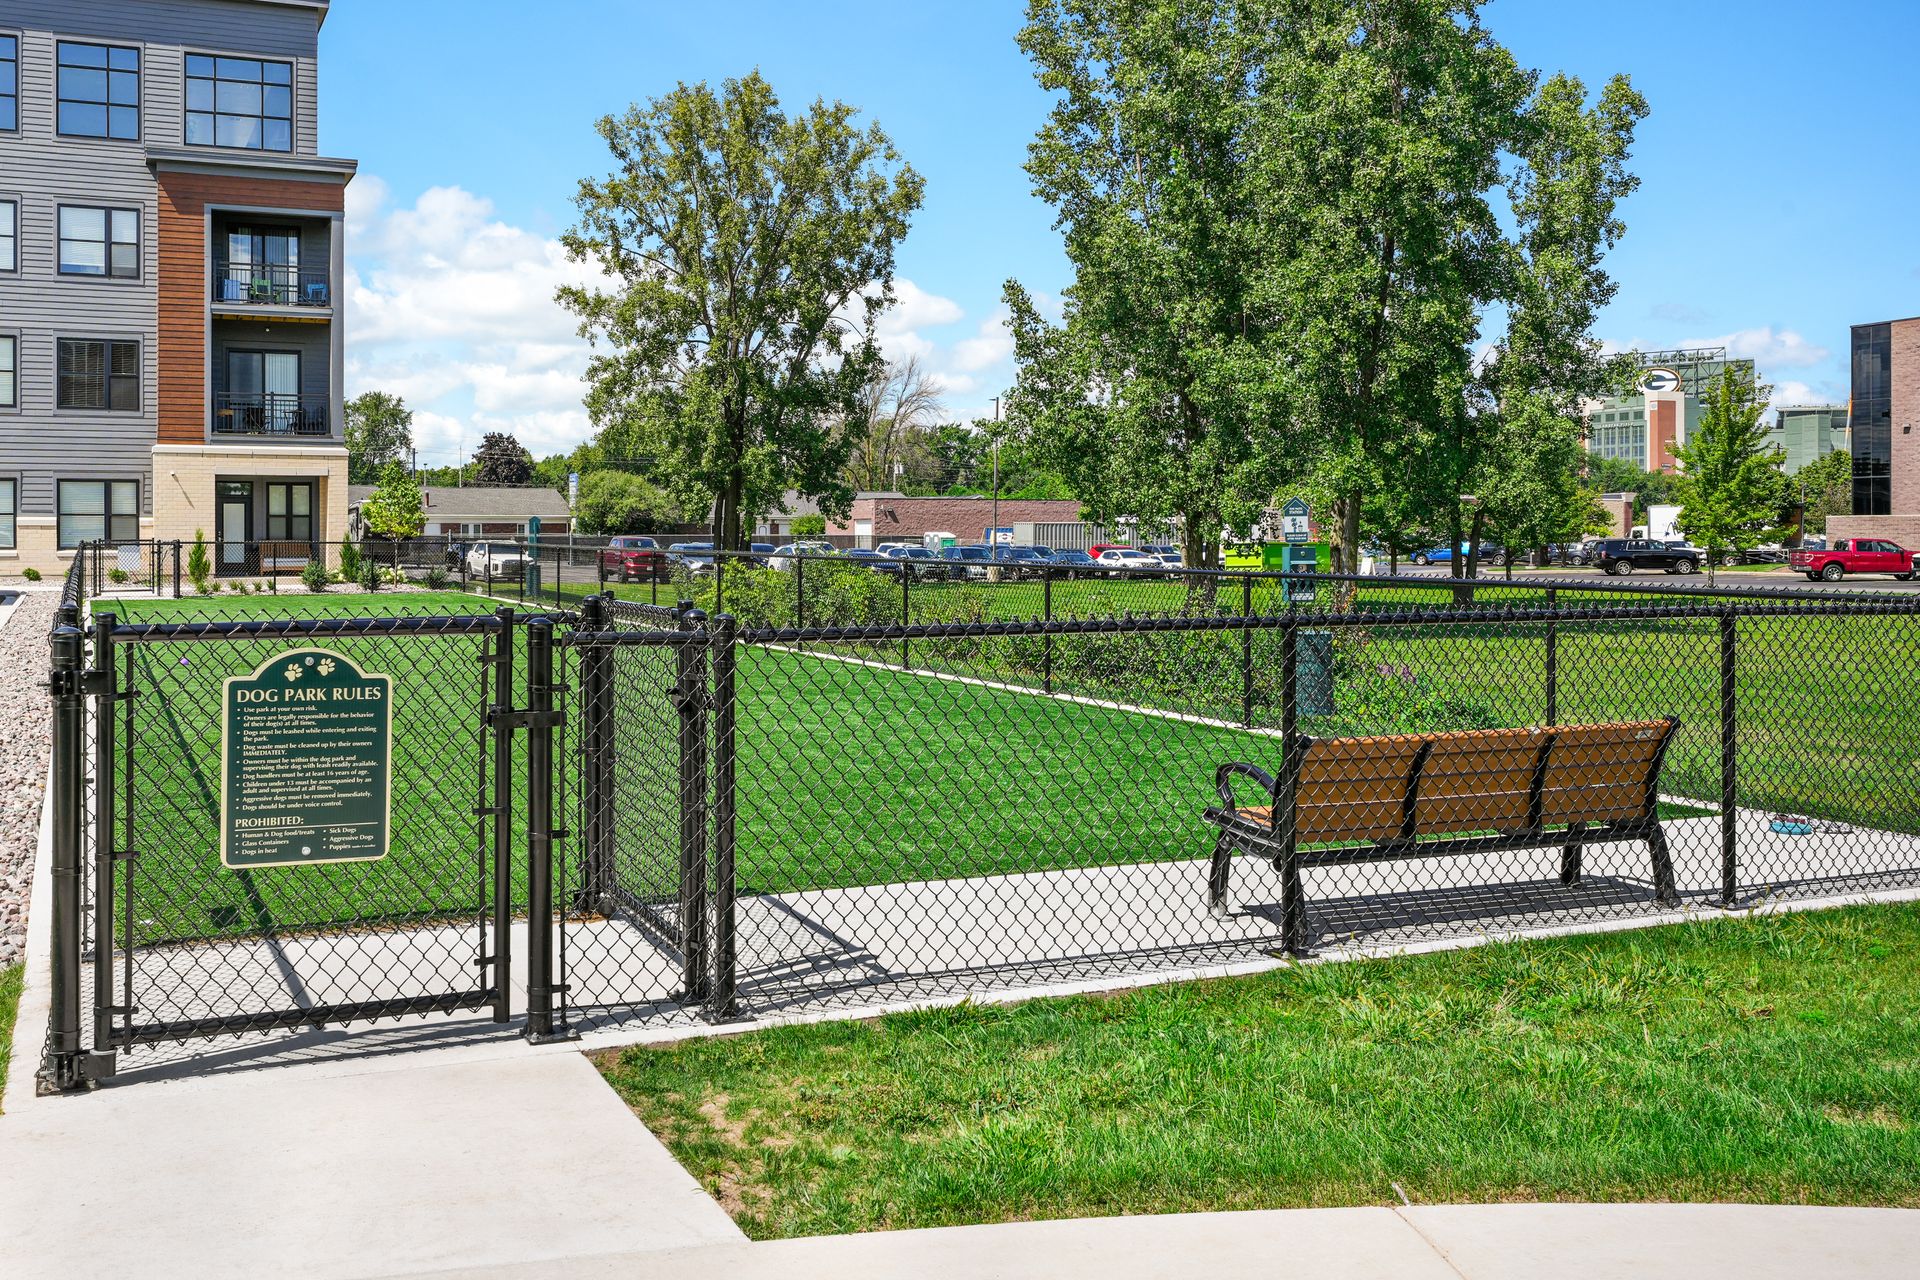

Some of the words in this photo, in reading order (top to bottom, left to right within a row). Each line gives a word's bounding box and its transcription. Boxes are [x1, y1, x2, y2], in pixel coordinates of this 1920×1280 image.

[237, 689, 278, 703] DOG
[285, 688, 327, 702] PARK
[333, 687, 381, 700] RULES
[298, 713, 329, 721] responsible
[322, 726, 345, 734] entering
[243, 764, 275, 773] supervising
[332, 761, 351, 769] readily
[318, 777, 355, 786] accompanied
[271, 786, 301, 794] supervised
[242, 795, 273, 804] Aggressive
[337, 790, 372, 799] immediately.
[242, 804, 257, 812] Dogs
[235, 816, 304, 828] PROHIBITED:
[271, 831, 283, 839] Dog
[342, 827, 357, 835] Dogs
[329, 835, 359, 843] Aggressive
[360, 834, 374, 842] Dogs
[329, 843, 351, 852] Puppies
[242, 848, 257, 857] Dogs
